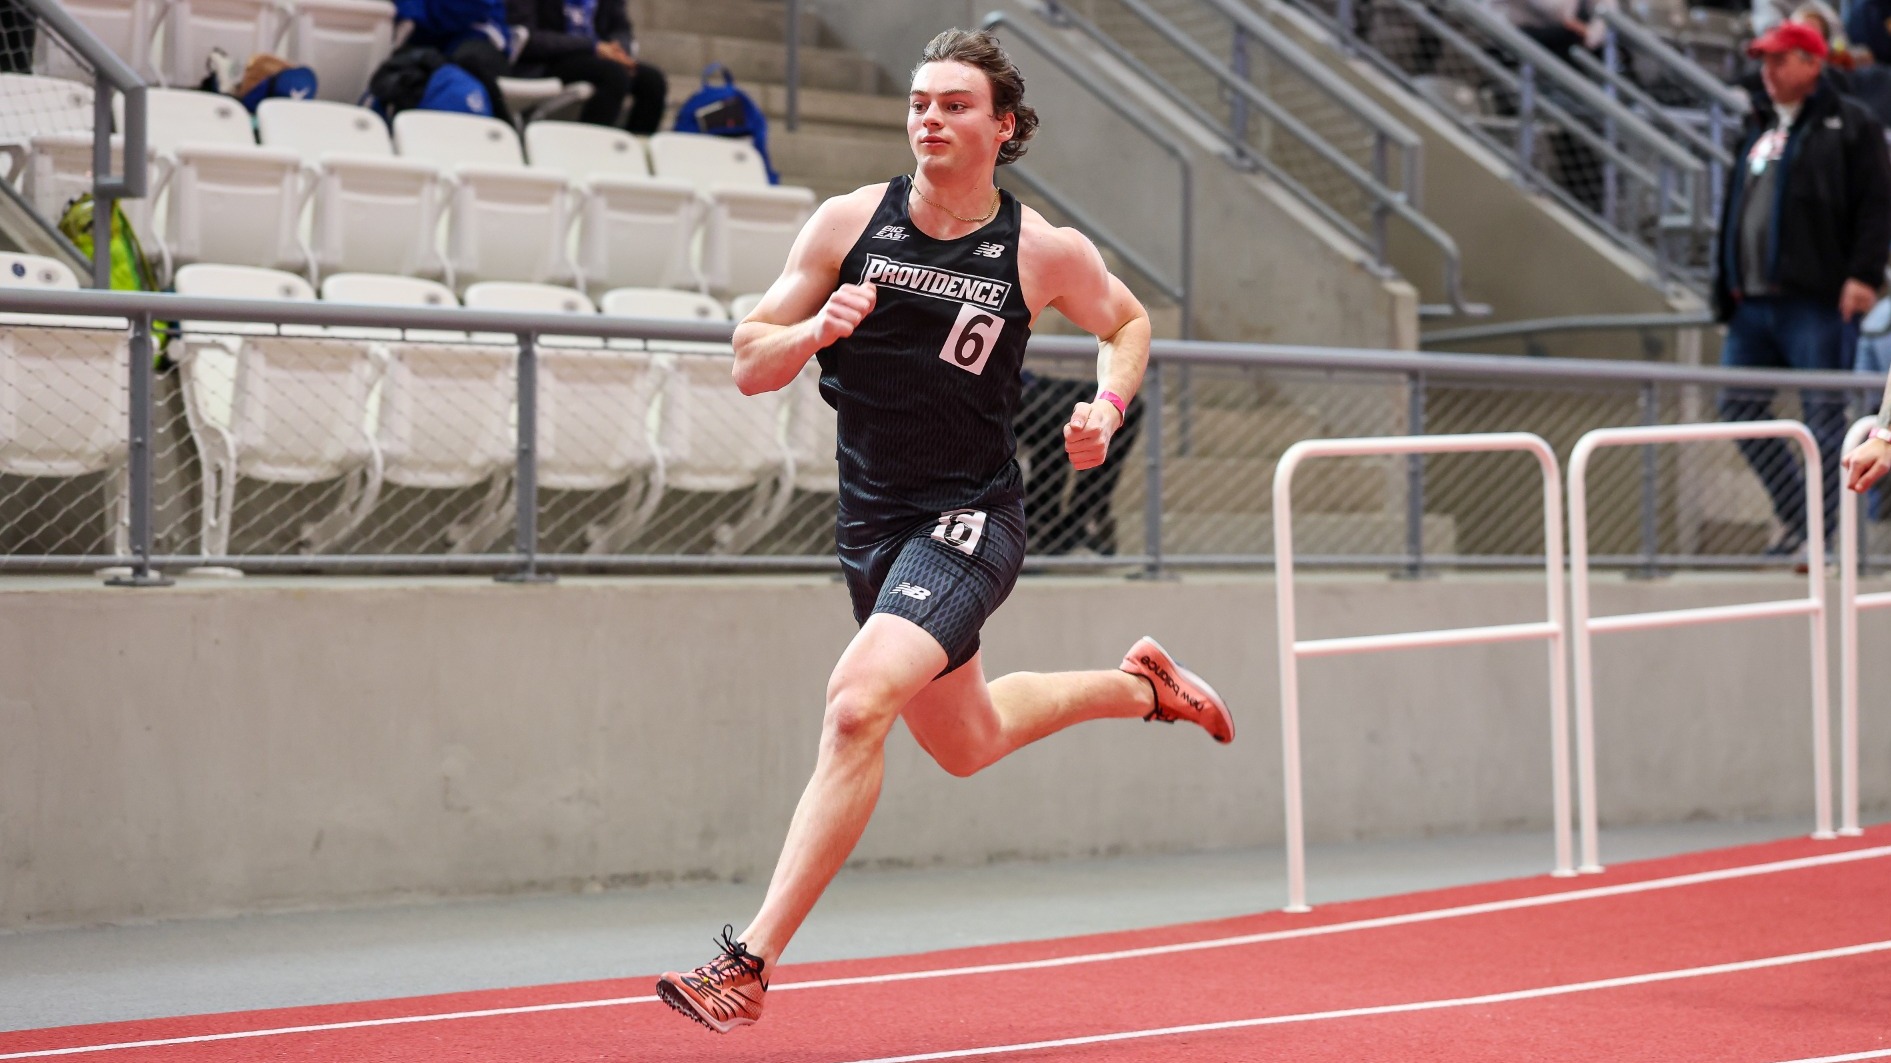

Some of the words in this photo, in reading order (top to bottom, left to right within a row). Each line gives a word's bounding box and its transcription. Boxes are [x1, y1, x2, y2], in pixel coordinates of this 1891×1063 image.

[873, 230, 910, 241] EAST
[881, 225, 906, 233] BIG
[865, 258, 1006, 306] PROVIDENCE
[954, 314, 994, 367] 6
[1141, 656, 1180, 696] balance
[1181, 691, 1204, 712] new
